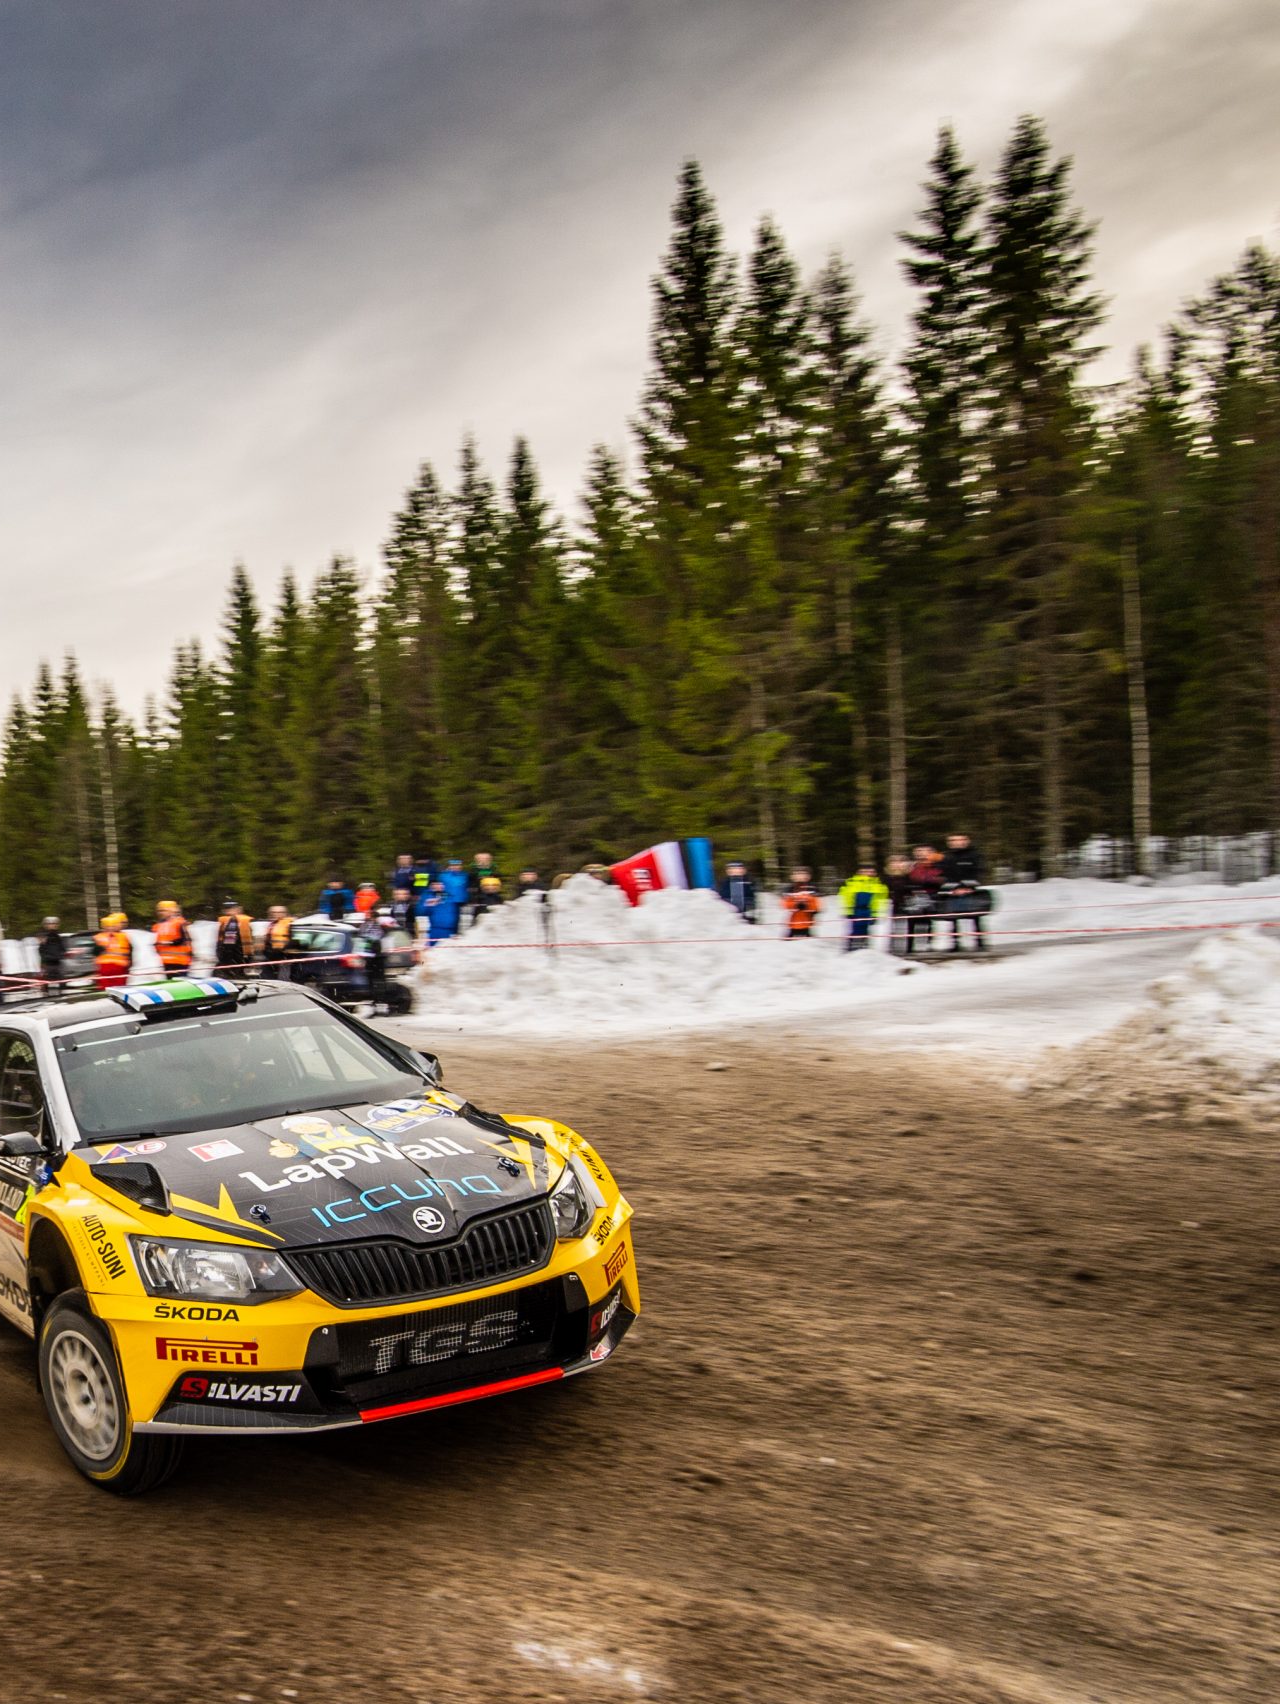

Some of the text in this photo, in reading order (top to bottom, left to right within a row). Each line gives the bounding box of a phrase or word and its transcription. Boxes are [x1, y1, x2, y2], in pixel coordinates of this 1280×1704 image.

[238, 1136, 475, 1193] LapWall
[81, 1214, 126, 1280] AUTO-SUNI
[591, 1215, 616, 1246] ŠKODA
[602, 1240, 629, 1288] PIRELLI
[154, 1302, 240, 1322] ŠKODA
[155, 1336, 259, 1366] PIRELLI
[370, 1310, 518, 1375] TGS
[180, 1377, 301, 1402] SILVASTI
